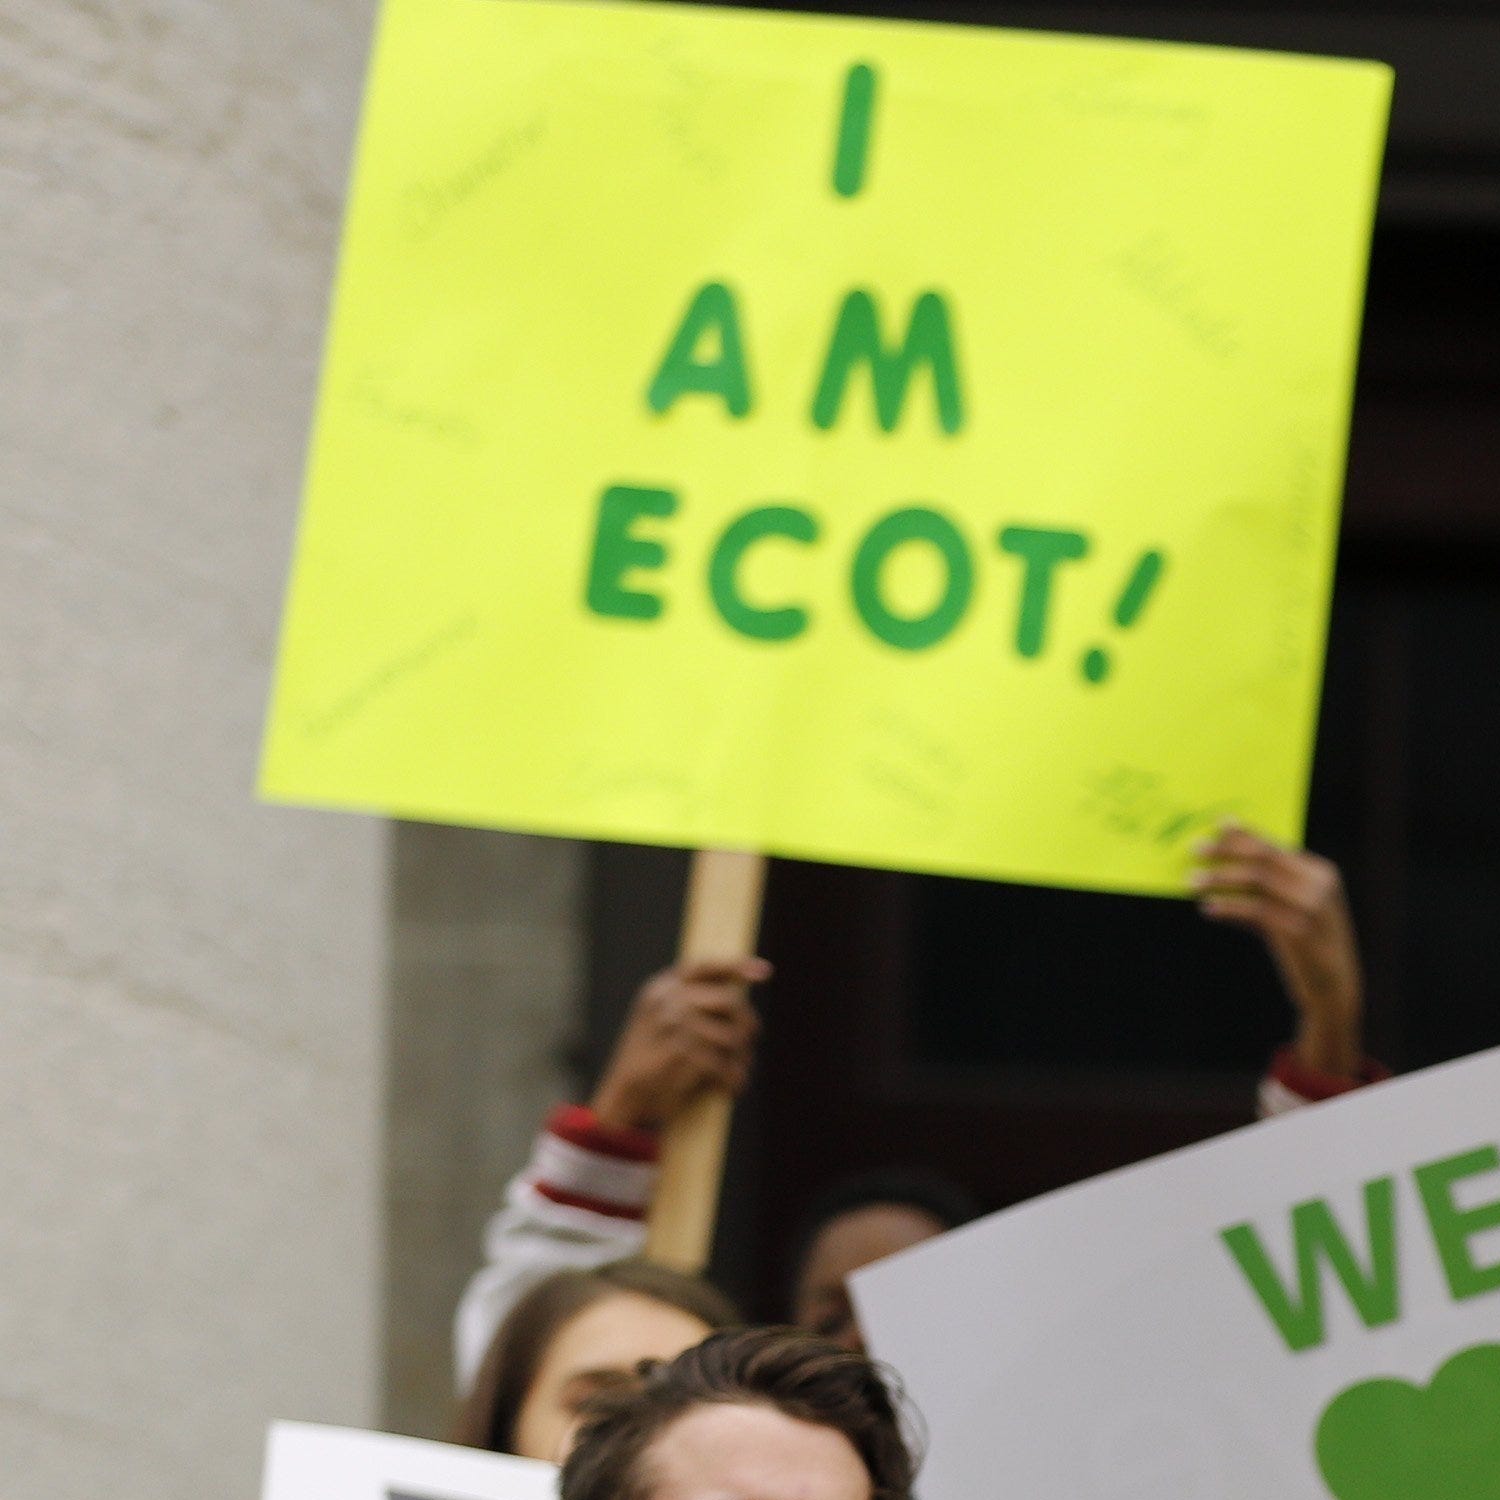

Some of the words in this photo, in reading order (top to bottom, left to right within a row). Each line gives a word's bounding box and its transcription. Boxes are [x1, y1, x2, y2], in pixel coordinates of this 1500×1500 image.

[830, 60, 877, 198] I
[643, 281, 966, 436] AM
[583, 483, 1164, 685] ECOT!
